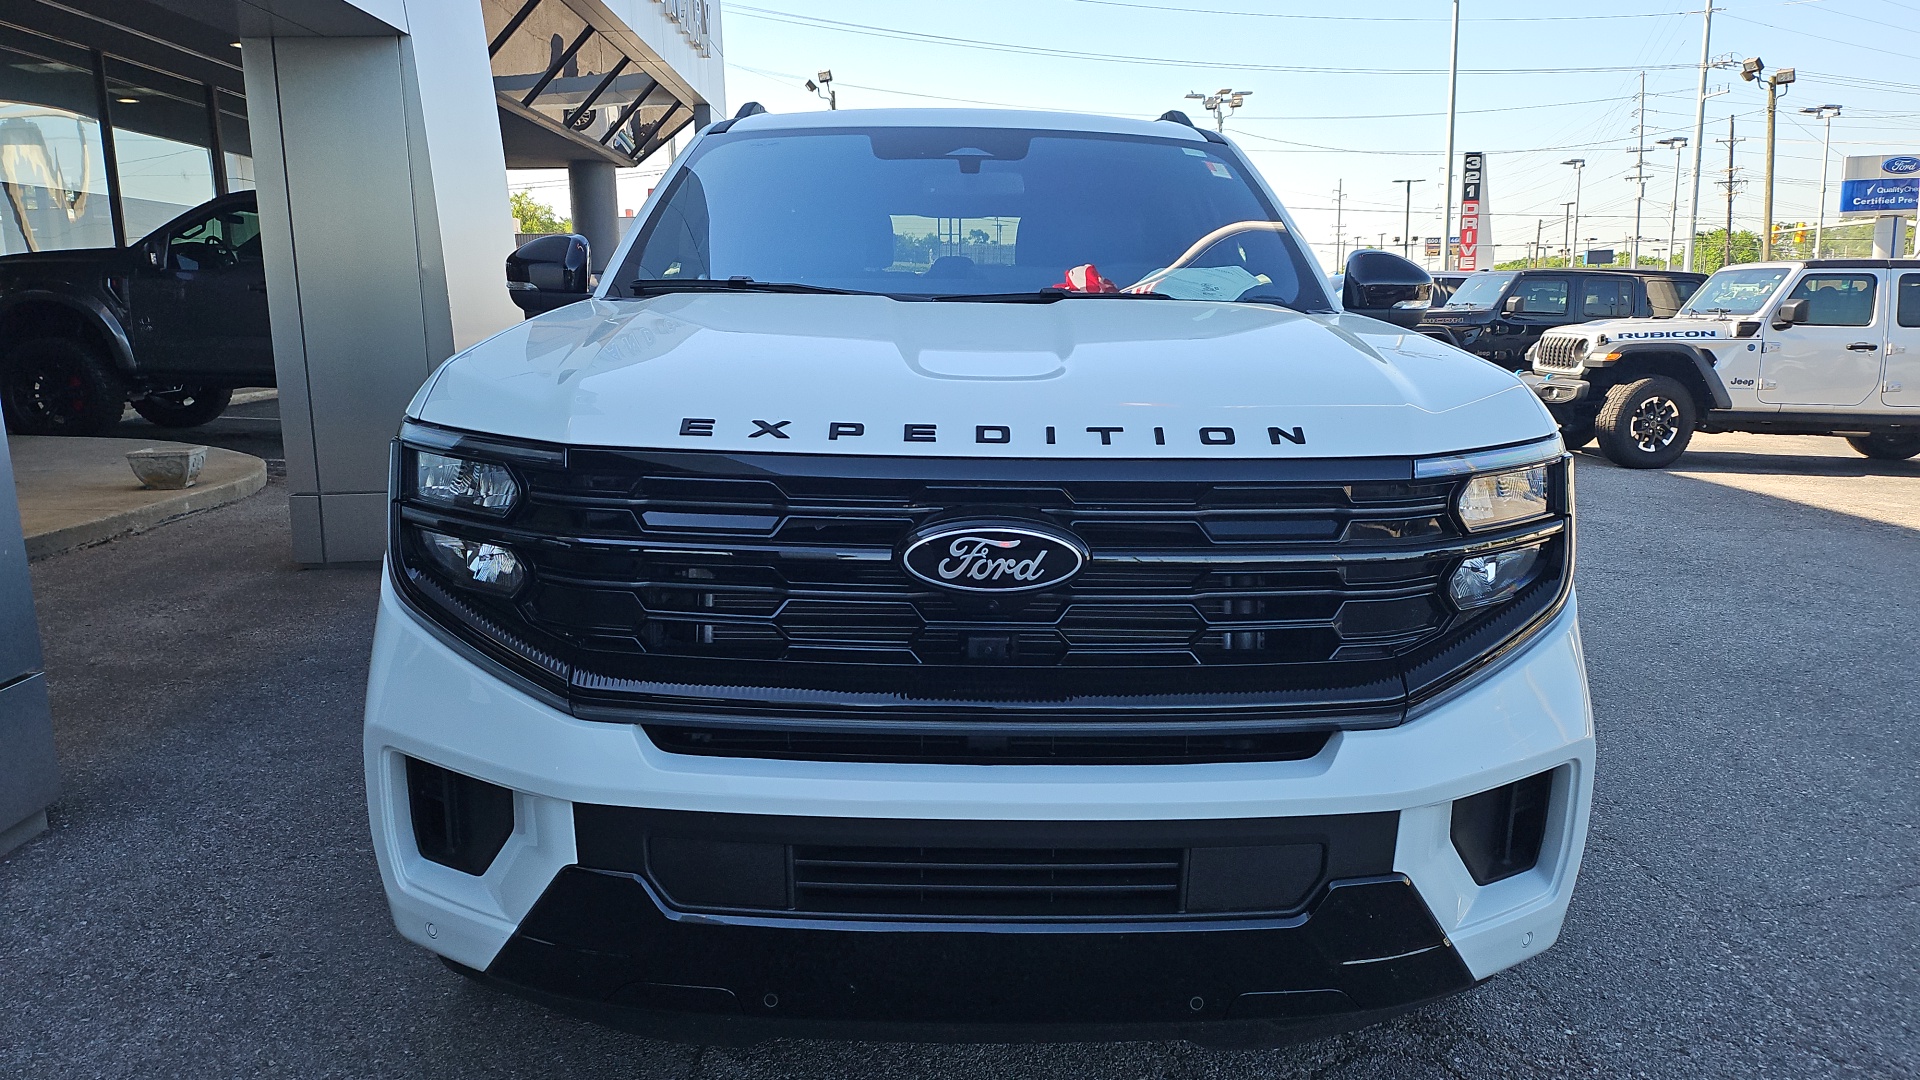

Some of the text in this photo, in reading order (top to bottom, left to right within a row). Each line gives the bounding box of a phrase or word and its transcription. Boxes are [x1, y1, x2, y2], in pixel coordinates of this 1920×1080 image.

[1892, 160, 1917, 171] Ford
[1877, 186, 1918, 194] QualityChe
[1853, 197, 1895, 205] Certified
[1460, 156, 1481, 269] 321 DRIVE
[1618, 330, 1716, 339] RUBICON
[1730, 377, 1755, 387] Jeep
[679, 418, 1306, 445] EXPEDITION
[938, 536, 1048, 581] Ford
